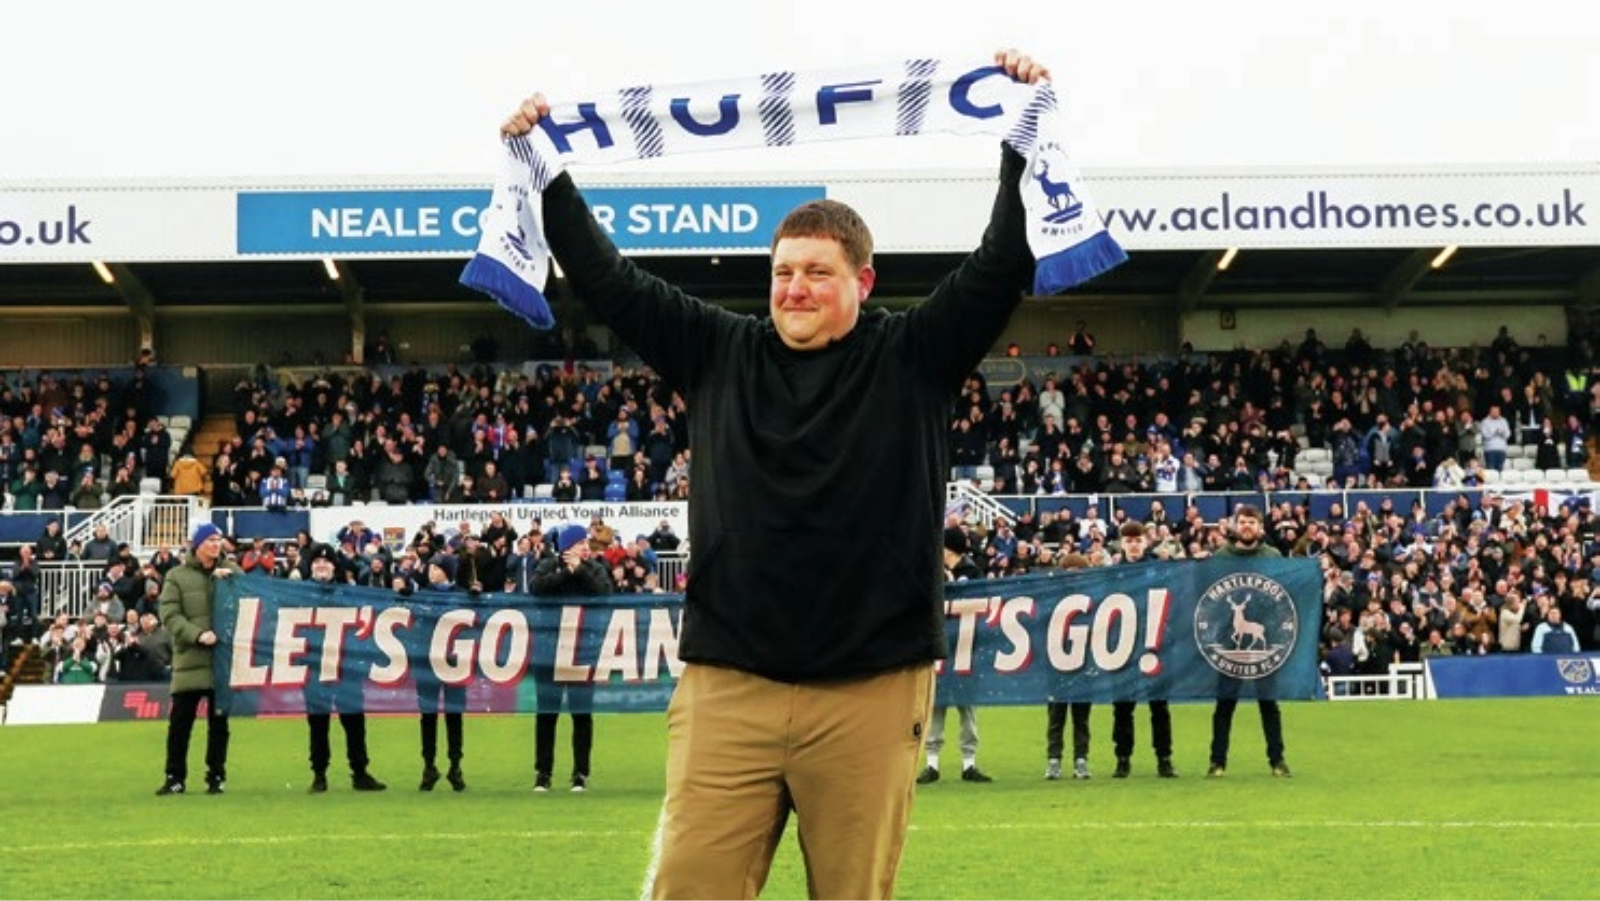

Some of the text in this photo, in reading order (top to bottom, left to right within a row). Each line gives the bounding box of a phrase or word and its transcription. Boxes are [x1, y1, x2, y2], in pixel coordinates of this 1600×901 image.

[0, 205, 91, 245] o.uk
[311, 207, 441, 238] NEALE
[627, 203, 759, 233] STAND
[433, 507, 512, 522] Hartlepol
[517, 505, 568, 520] United
[619, 504, 680, 517] Alliance
[1208, 576, 1284, 601] HARTLEPOOL
[229, 597, 413, 690] LET'S
[429, 608, 534, 688] GO
[937, 595, 1036, 675] T'S
[1047, 588, 1172, 675] GO!
